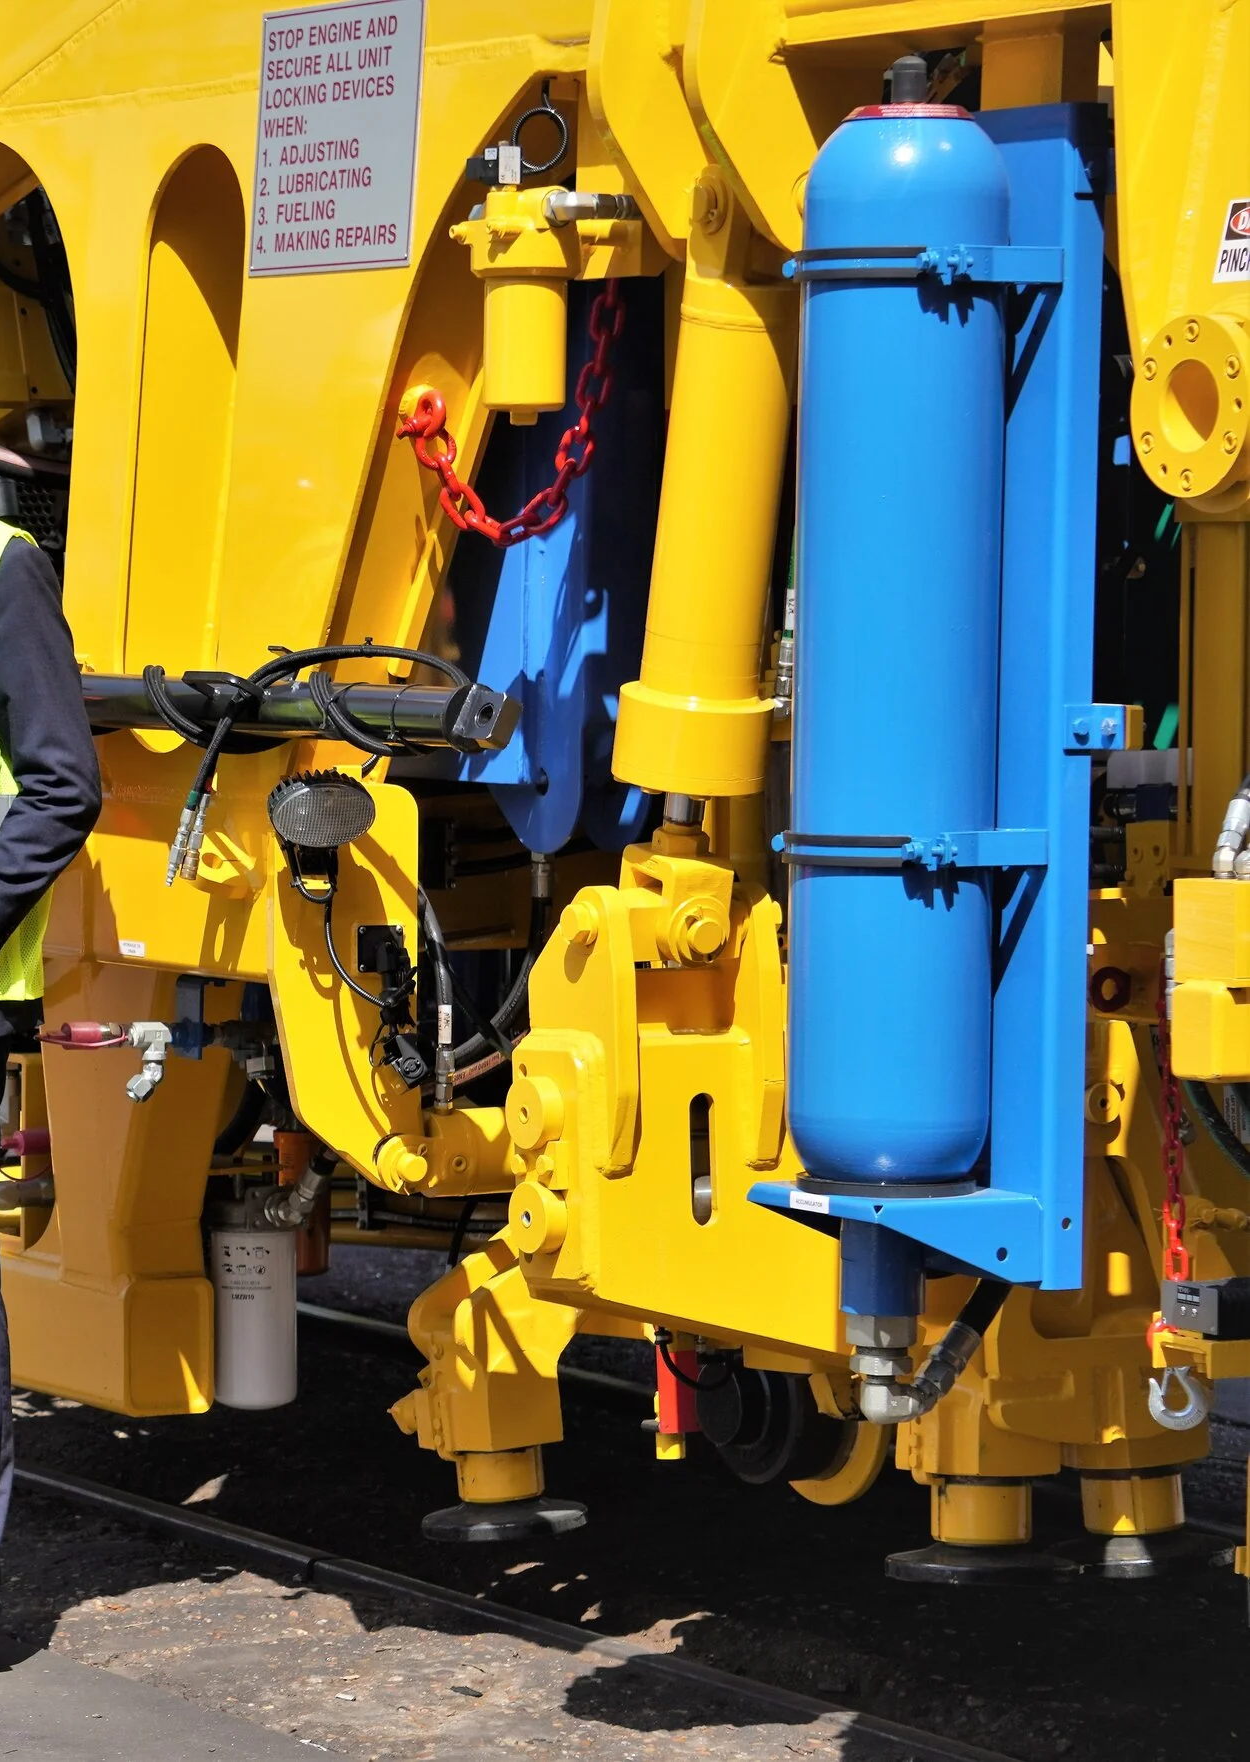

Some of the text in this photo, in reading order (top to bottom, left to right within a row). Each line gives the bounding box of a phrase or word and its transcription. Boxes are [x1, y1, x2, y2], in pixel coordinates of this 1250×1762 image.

[268, 15, 398, 52] STOP ENGINE AND
[266, 45, 393, 81] SECURE ALL UNIT
[265, 74, 395, 110] LOCKING DEVICES
[264, 115, 308, 139] WHEN:
[262, 138, 360, 168] 1. ADJUSTING
[259, 166, 372, 197] 2. LUBRICATING
[258, 199, 335, 226] 3. FUELING
[256, 223, 397, 254] 4. MAKING REPAIRS
